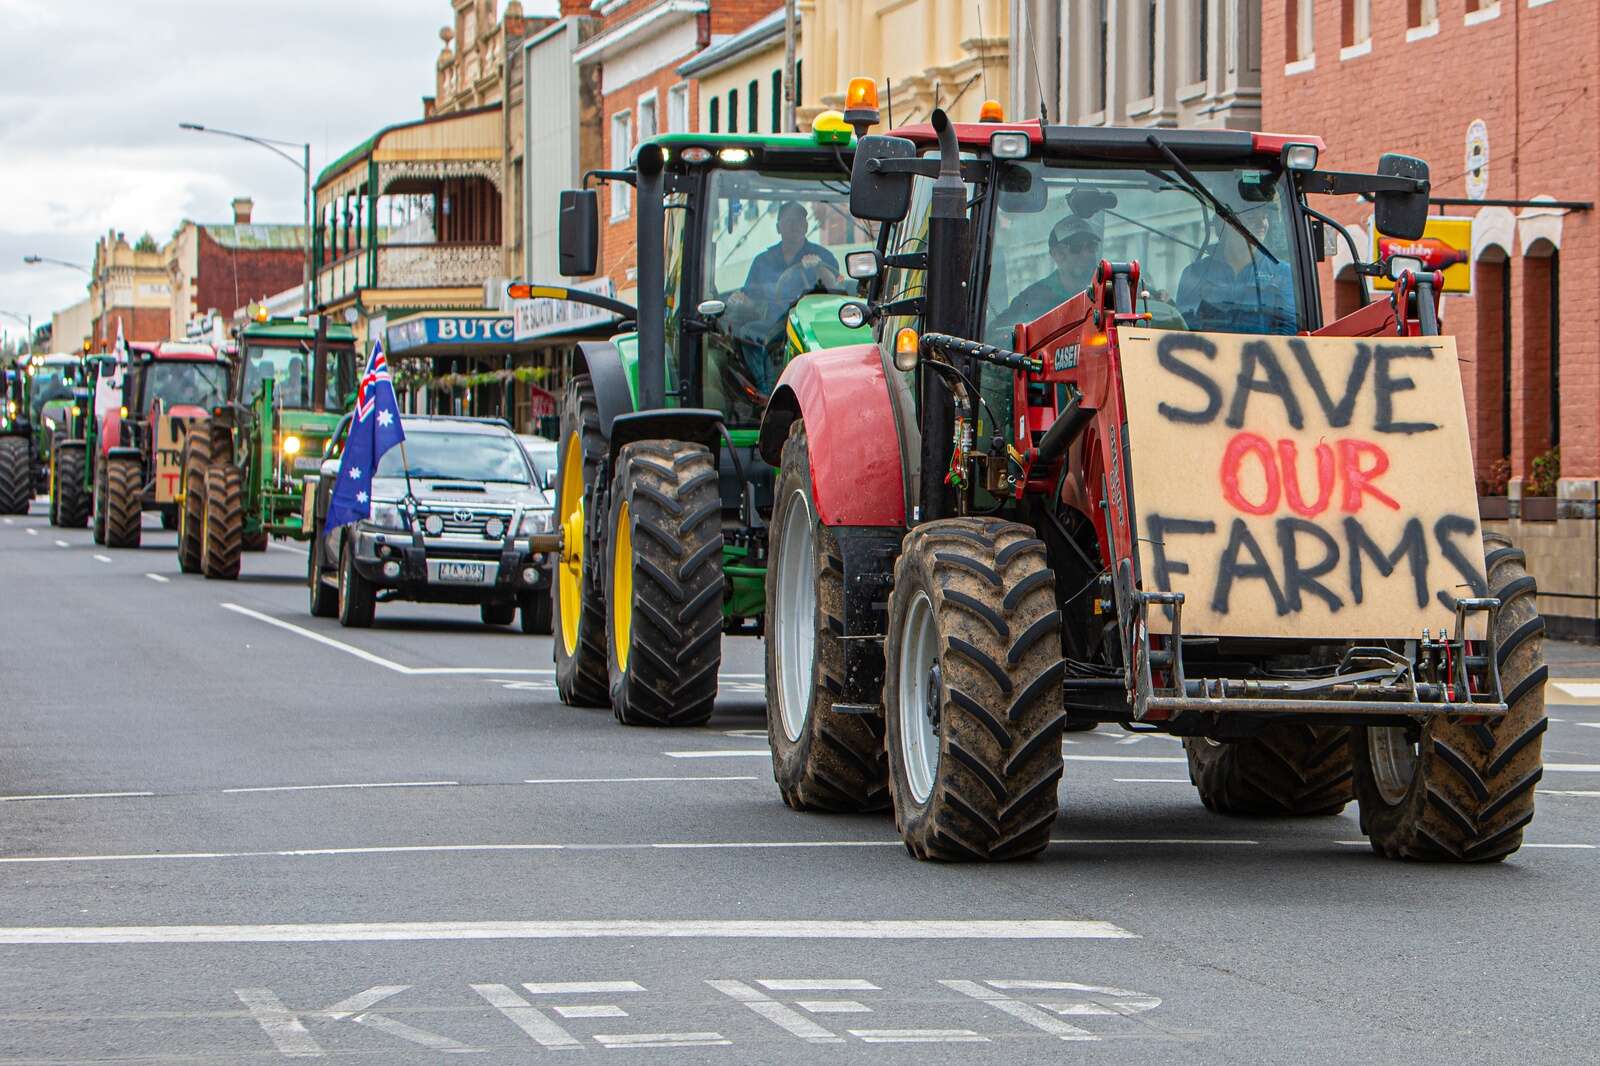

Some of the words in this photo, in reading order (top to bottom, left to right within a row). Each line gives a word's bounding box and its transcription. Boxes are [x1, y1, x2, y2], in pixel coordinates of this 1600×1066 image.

[1157, 333, 1443, 435] SAVE
[1219, 432, 1401, 518] OUR
[1147, 512, 1489, 622] FARMS
[234, 979, 1162, 1056] KEEP
